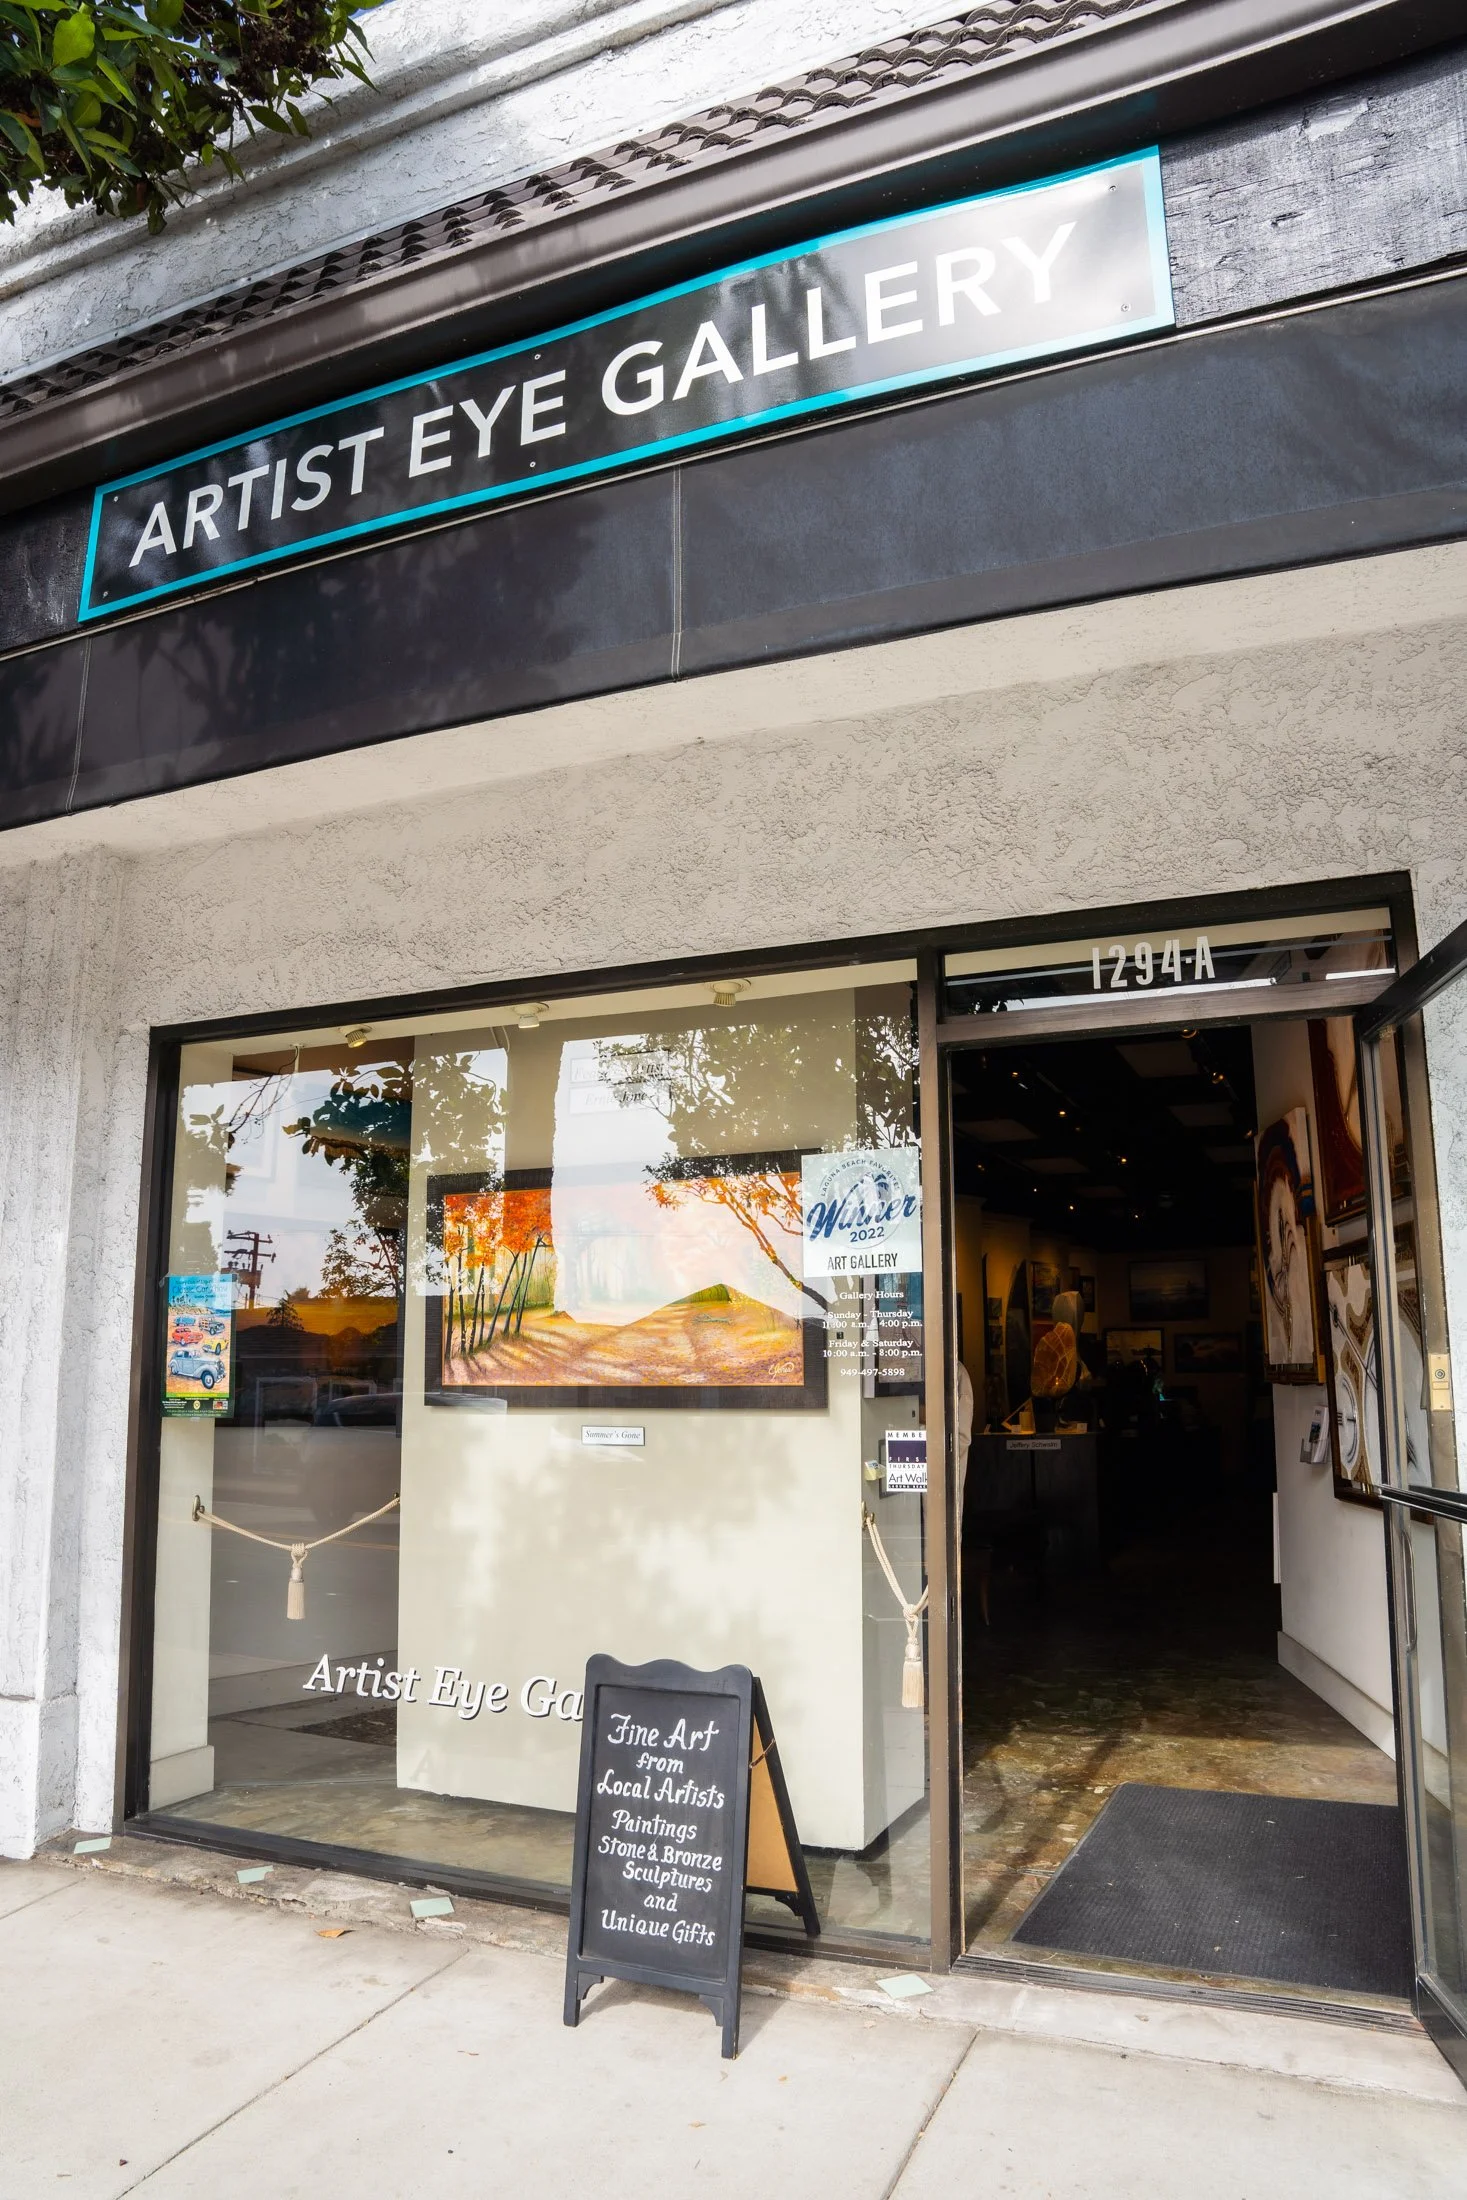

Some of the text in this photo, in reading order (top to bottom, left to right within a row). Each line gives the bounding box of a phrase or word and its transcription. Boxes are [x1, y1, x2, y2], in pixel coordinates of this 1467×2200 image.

[129, 221, 1077, 567] ARTIST EYE GALLERY
[820, 1169, 841, 1197] LAGUNA
[842, 1159, 866, 1170] BEACH
[806, 1191, 918, 1242] Winner
[850, 1226, 885, 1243] 2022
[828, 1253, 898, 1271] ART GALLERY
[839, 1292, 873, 1300] Gallery
[828, 1311, 861, 1319] Sunday
[870, 1310, 914, 1318] Thursday
[879, 1320, 899, 1328] 4:00
[902, 1321, 923, 1329] p.m.
[829, 1340, 858, 1349] Friday
[872, 1339, 914, 1348] Saturday
[902, 1350, 923, 1358] p.m.
[840, 1368, 905, 1377] 949-497-5898
[621, 1431, 641, 1439] Gone
[889, 1473, 903, 1483] Art
[303, 1653, 421, 1702] Artist
[427, 1665, 508, 1720] Eye
[607, 1713, 720, 1751] Fine Art
[636, 1752, 684, 1774] from
[597, 1769, 725, 1809] Local Artists
[611, 1809, 698, 1844] Paintings
[598, 1835, 723, 1872] Stone & Bronze
[622, 1861, 713, 1893] Sculptures
[643, 1892, 678, 1912] and
[601, 1909, 716, 1946] Unique Gifts
